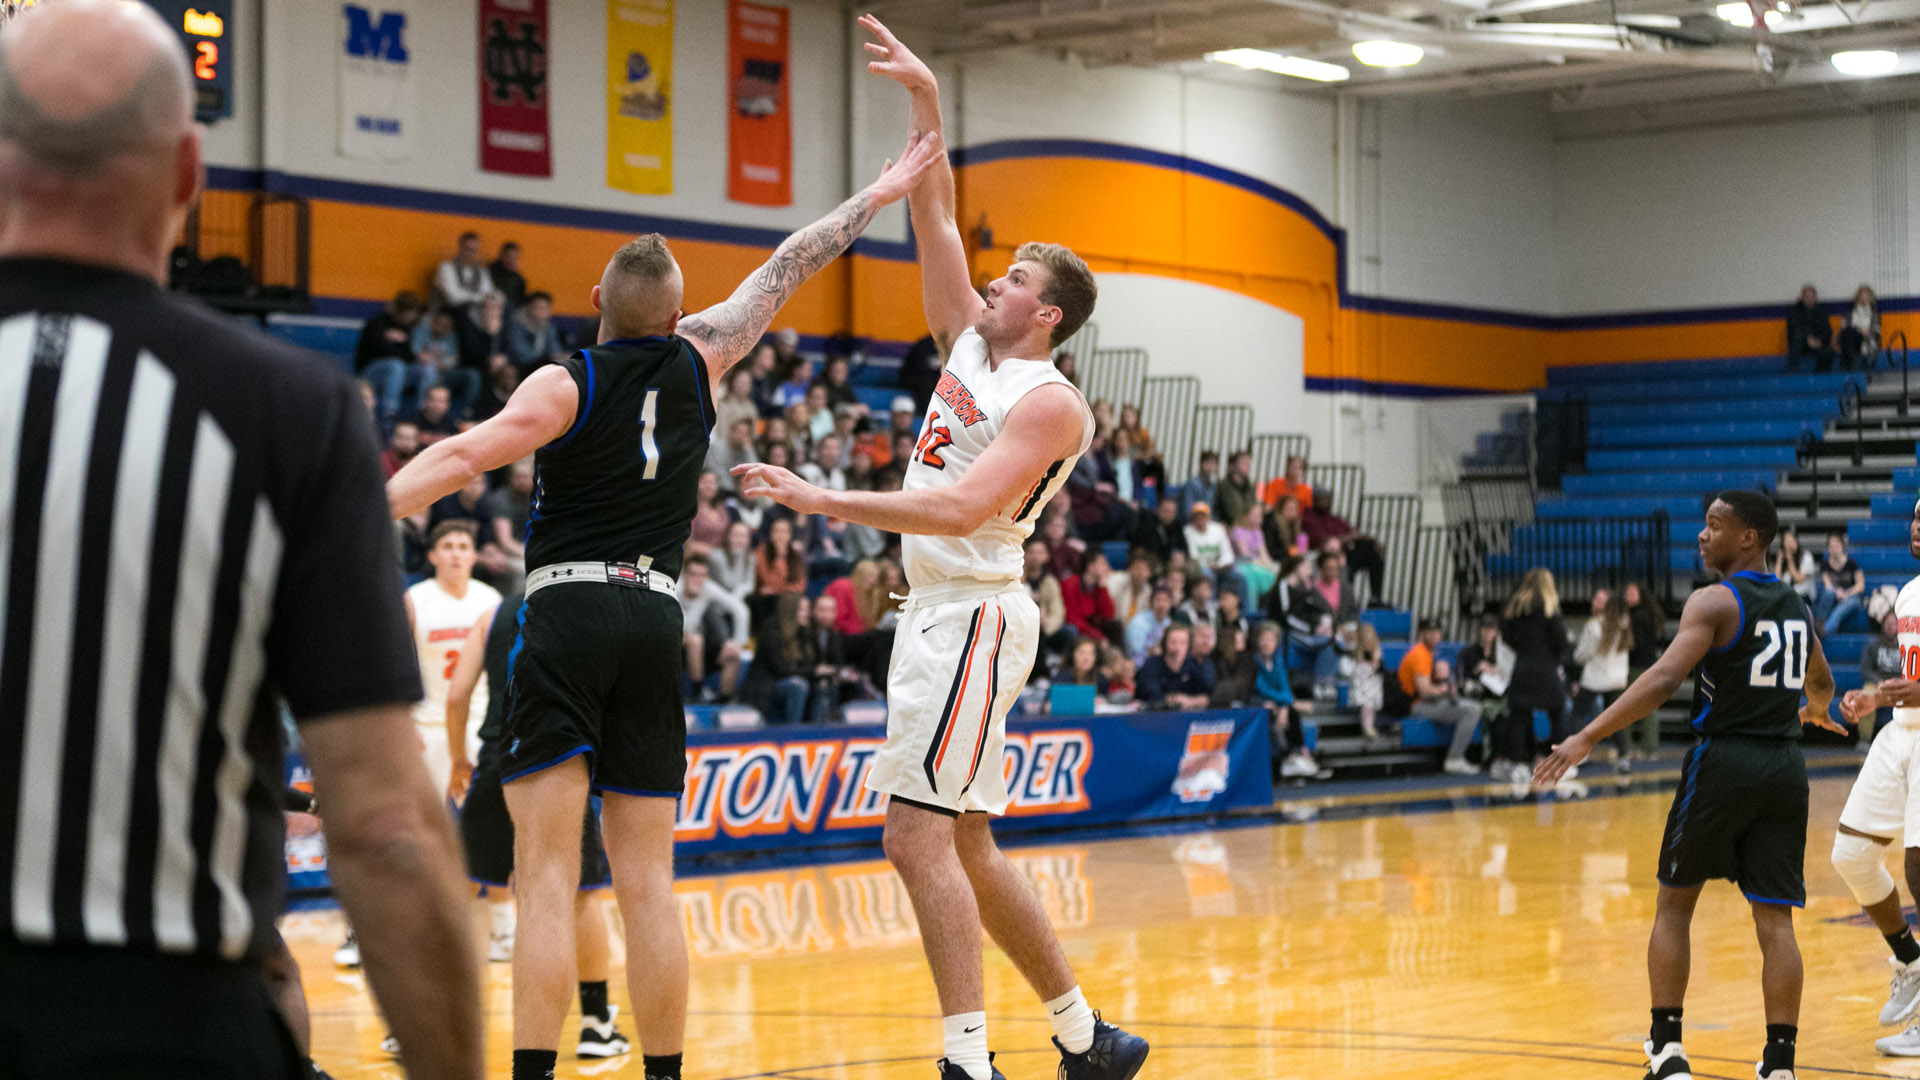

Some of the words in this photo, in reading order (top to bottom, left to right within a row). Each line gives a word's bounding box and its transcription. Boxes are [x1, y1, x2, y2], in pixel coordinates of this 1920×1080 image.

[195, 40, 218, 80] 2
[344, 4, 408, 64] M
[638, 388, 661, 482] 1
[914, 411, 954, 471] 42
[1749, 619, 1808, 690] 20
